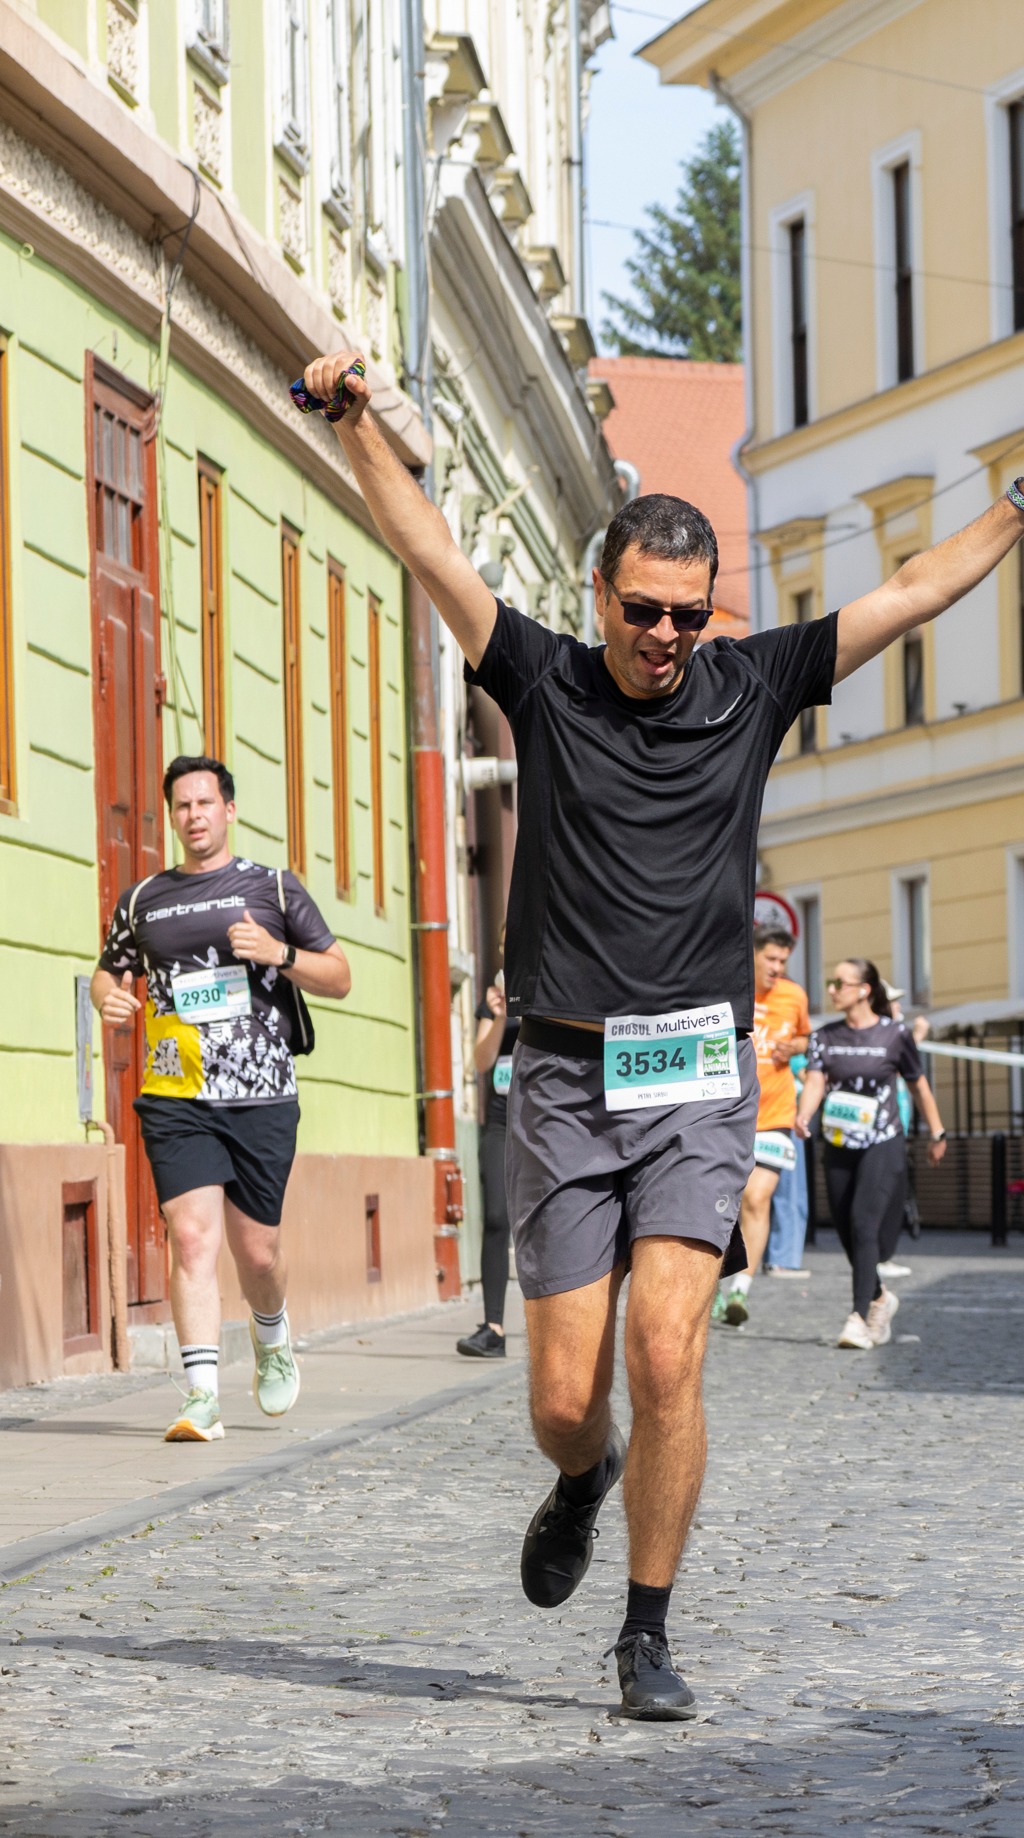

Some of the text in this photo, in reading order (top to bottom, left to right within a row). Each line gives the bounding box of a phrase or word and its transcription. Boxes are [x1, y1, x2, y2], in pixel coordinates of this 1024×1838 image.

[181, 988, 221, 1007] 2930
[611, 1023, 651, 1036] CROSUL
[616, 1047, 687, 1077] 3534
